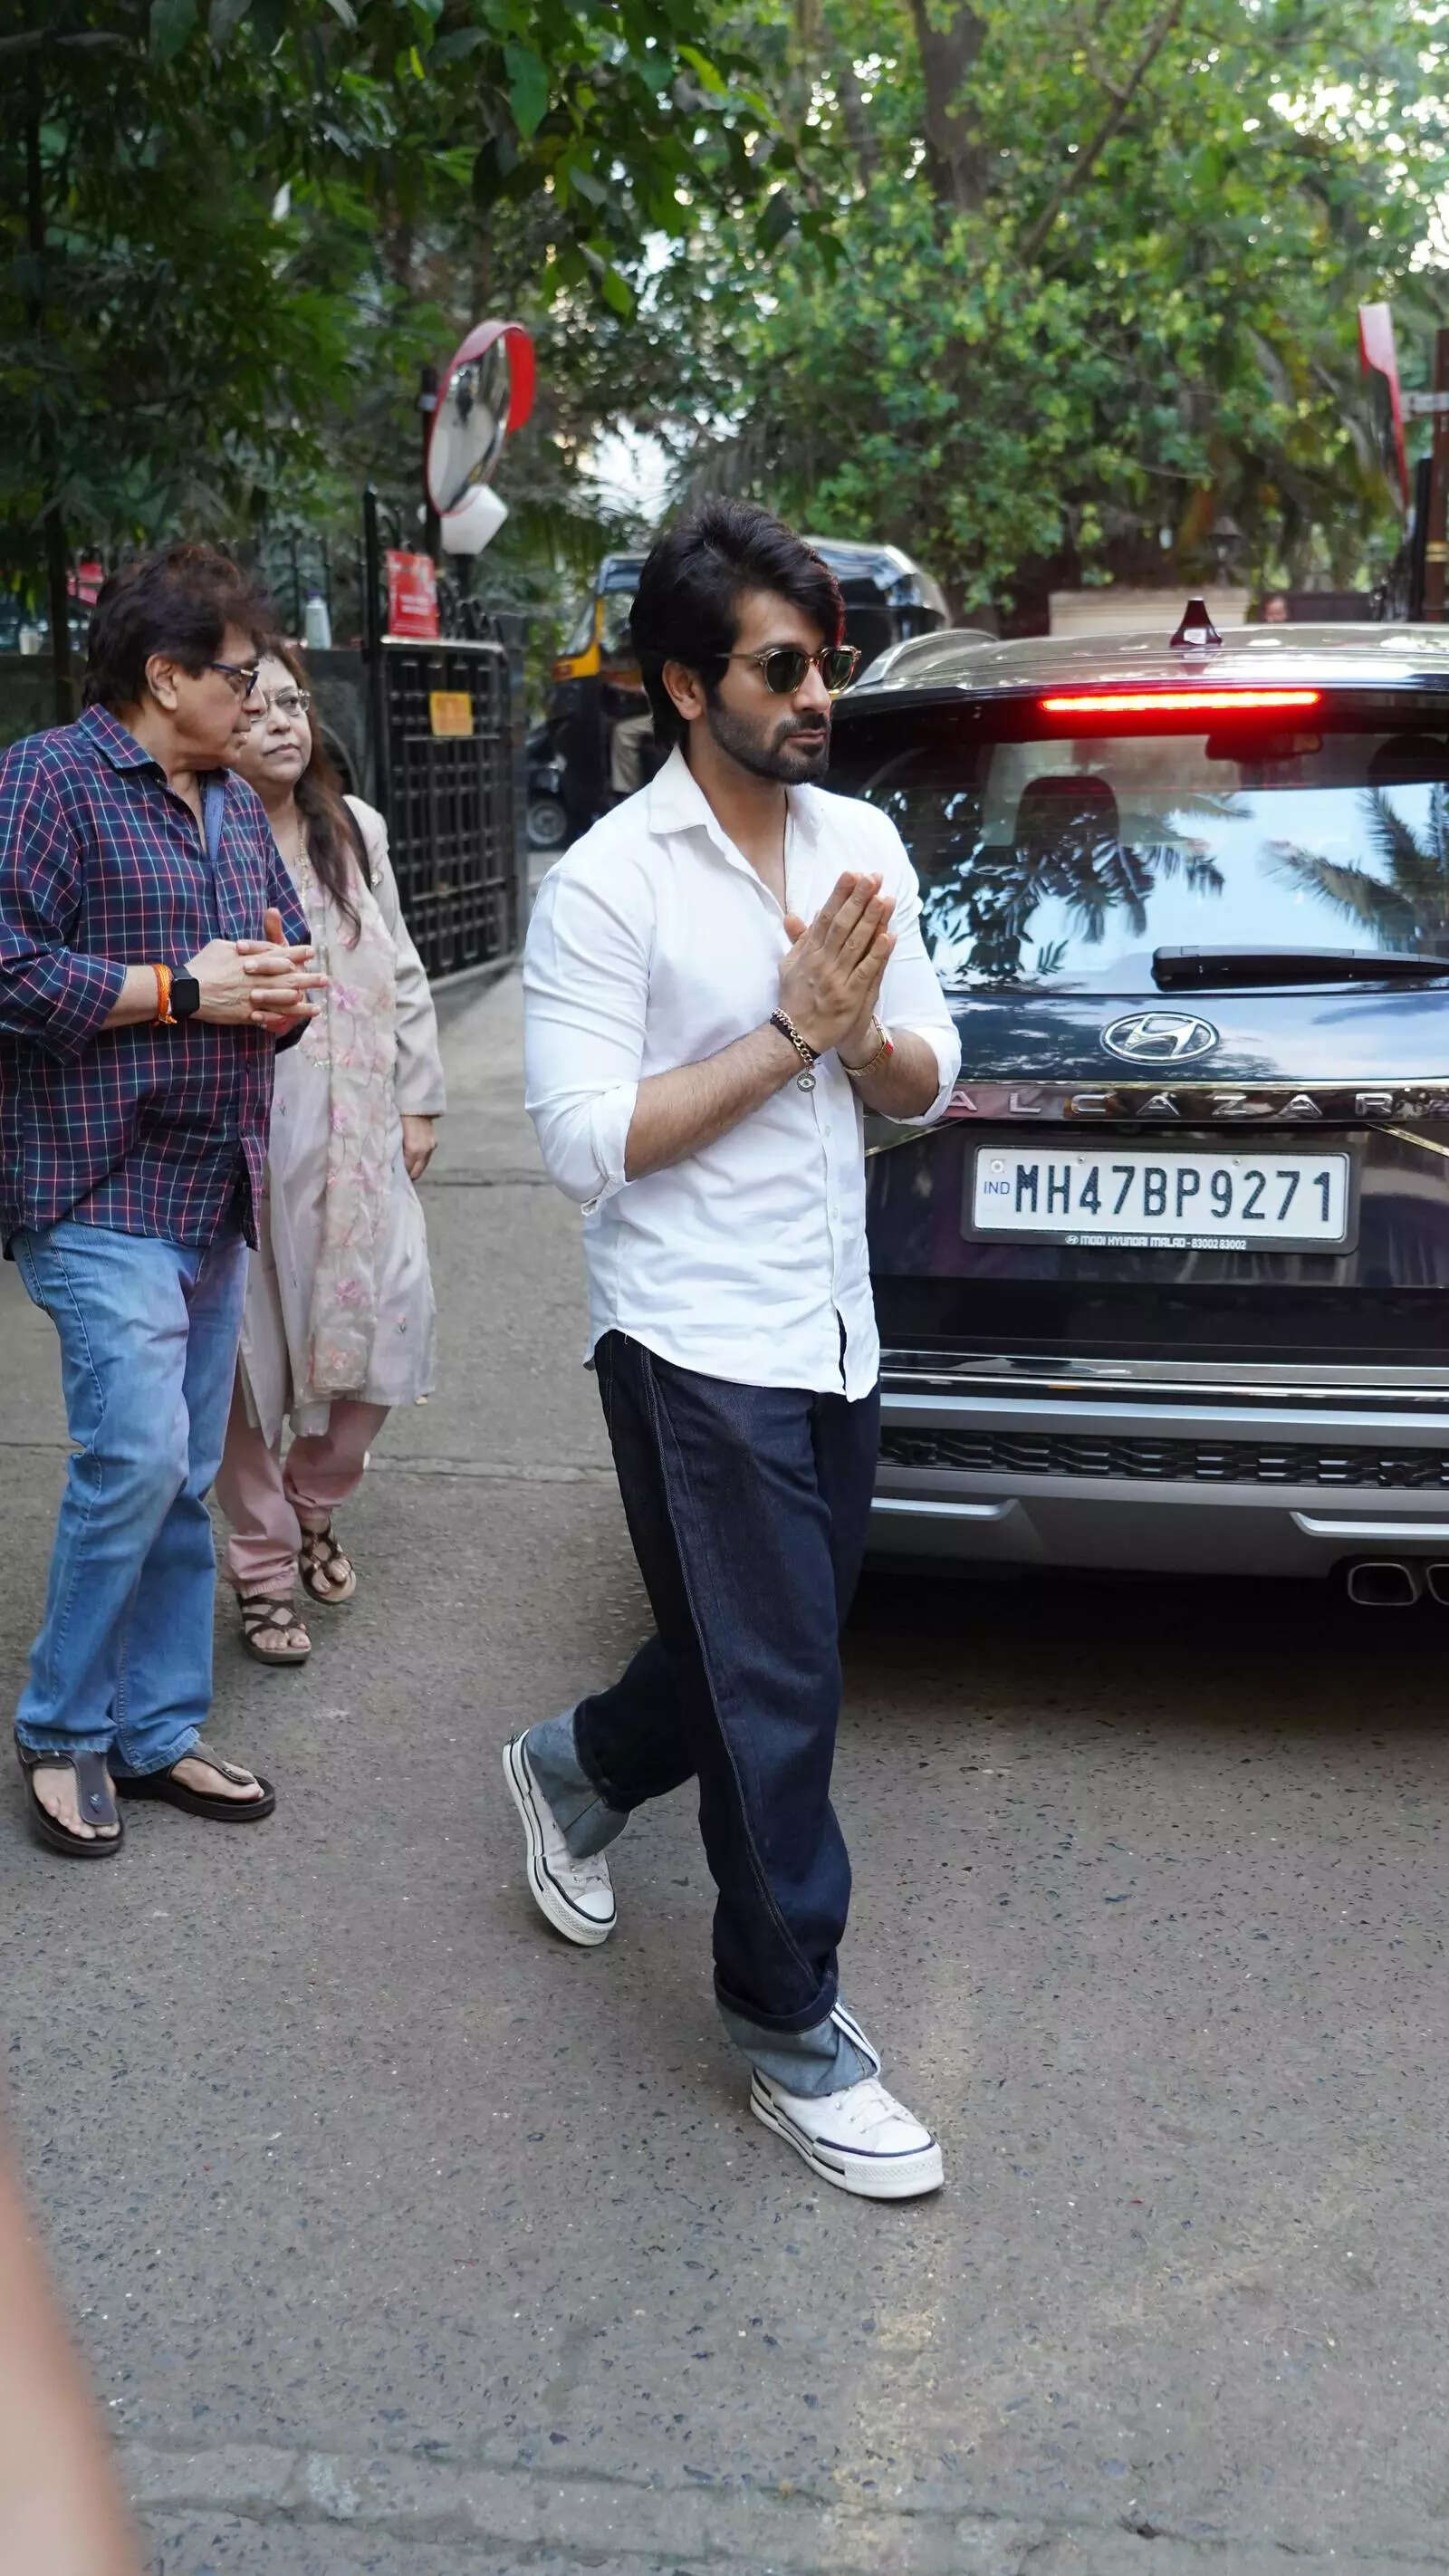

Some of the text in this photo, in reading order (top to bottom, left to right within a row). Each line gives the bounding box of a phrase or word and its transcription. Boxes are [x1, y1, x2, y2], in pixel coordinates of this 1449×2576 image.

[948, 1091, 1393, 1117] ALCAZAR
[984, 1181, 1011, 1195] IND
[1014, 1164, 1330, 1222] MH47BP9271
[1108, 1235, 1148, 1247] HYUNDAI
[1150, 1236, 1185, 1248] MALAD
